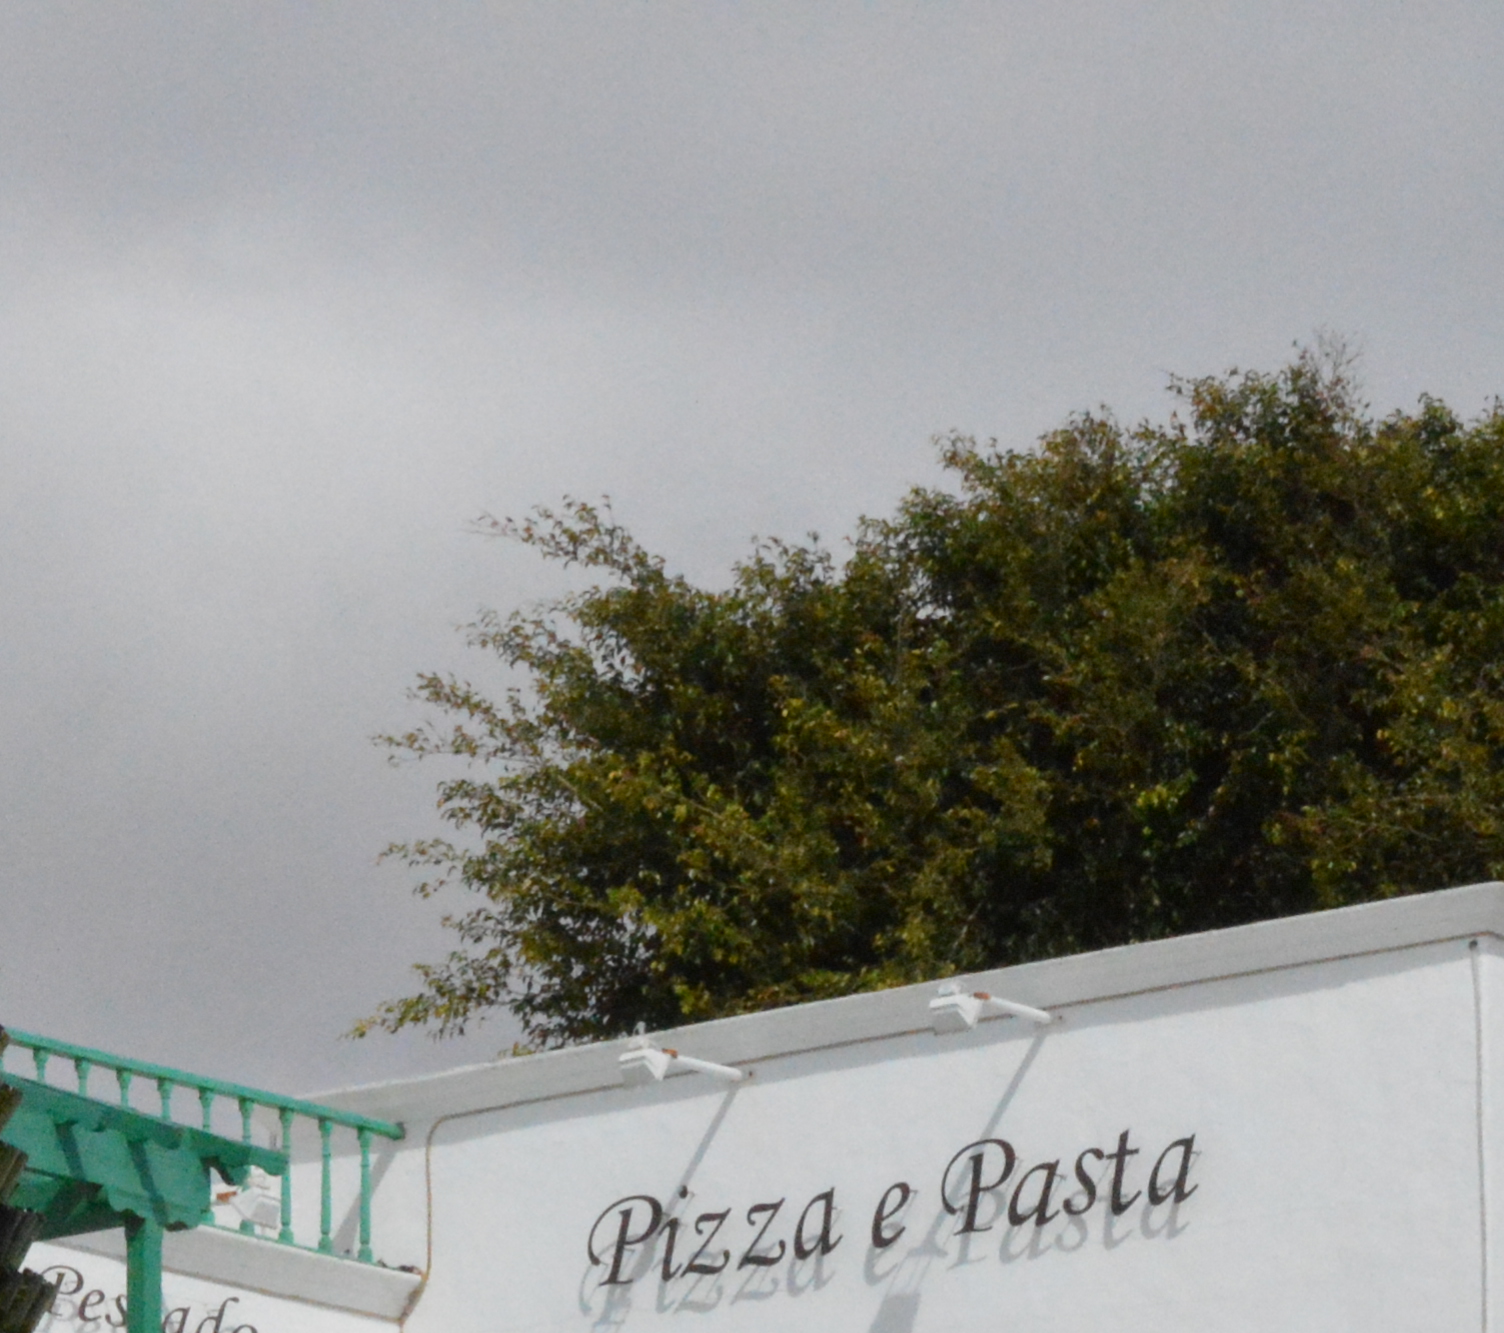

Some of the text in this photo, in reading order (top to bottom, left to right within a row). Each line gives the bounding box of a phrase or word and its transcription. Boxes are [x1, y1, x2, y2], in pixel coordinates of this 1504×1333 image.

[586, 1127, 1201, 1288] Pizza e Pasta
